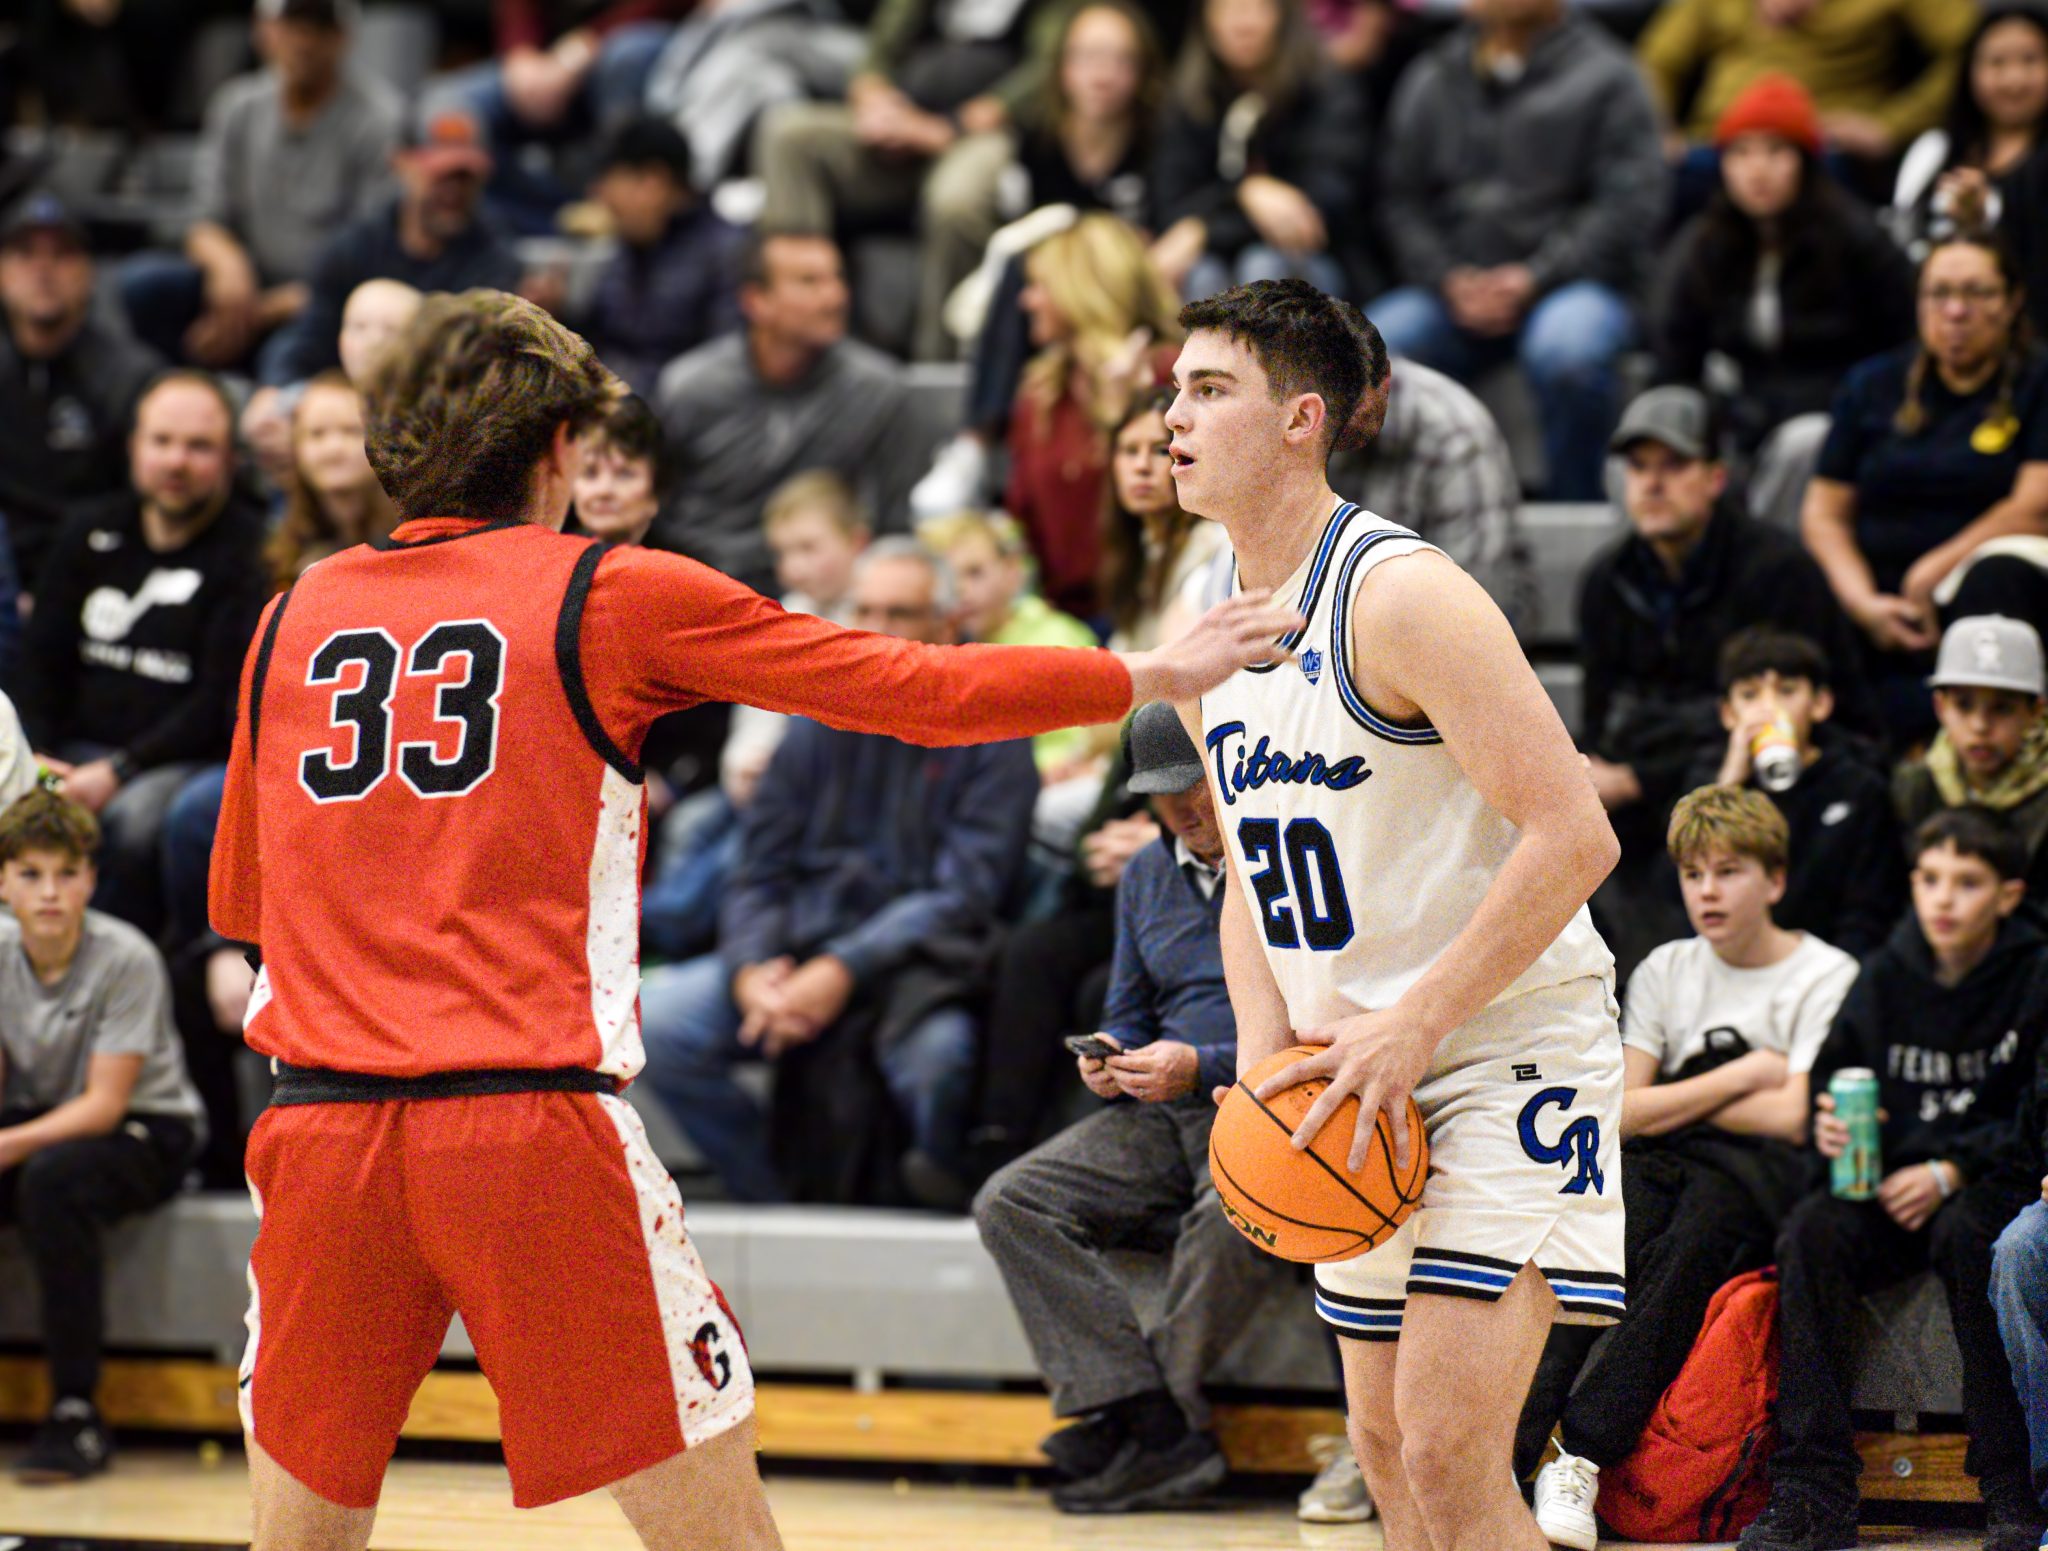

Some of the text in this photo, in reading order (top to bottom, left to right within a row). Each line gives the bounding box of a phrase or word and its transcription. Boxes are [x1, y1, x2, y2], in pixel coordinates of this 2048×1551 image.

[298, 618, 507, 805] 33
[1206, 720, 1373, 805] Titans
[1238, 817, 1355, 952] 20
[1517, 1086, 1604, 1195] CR
